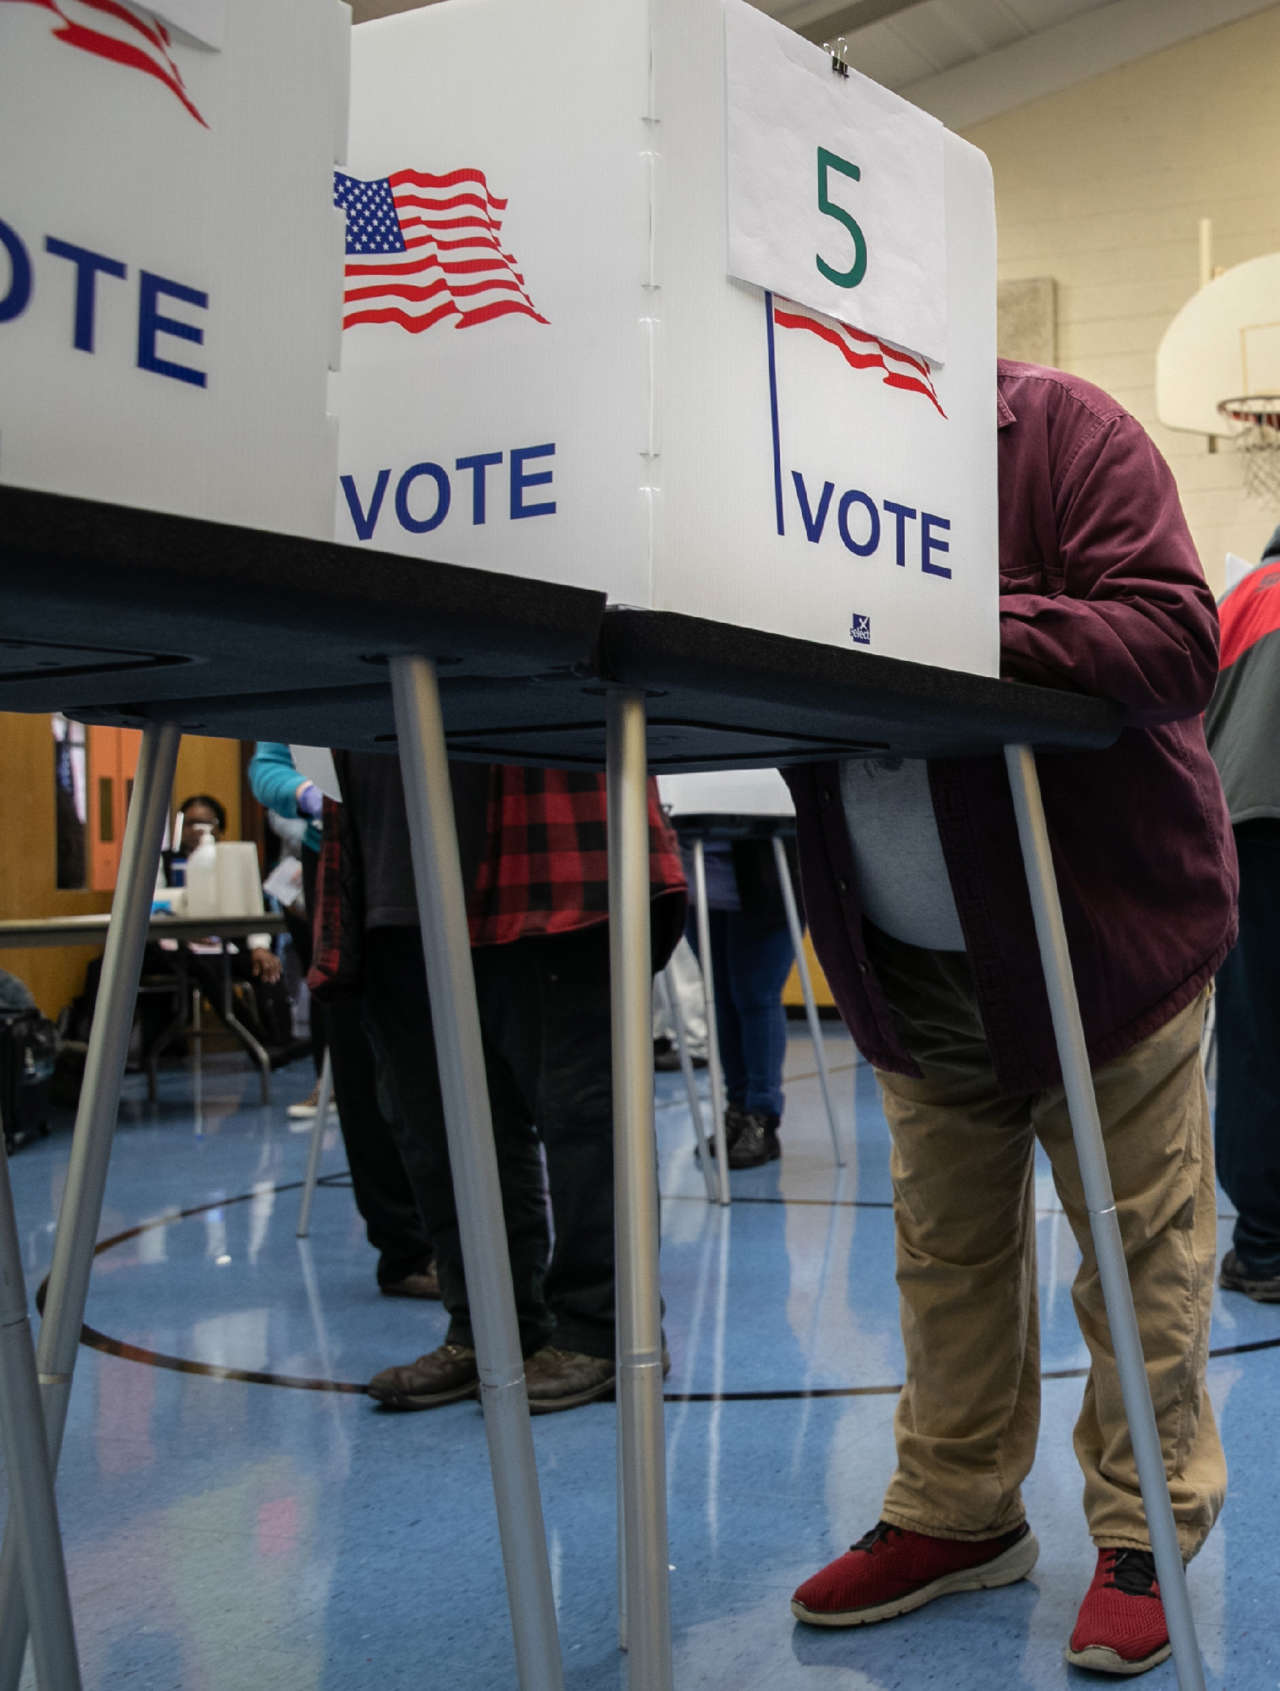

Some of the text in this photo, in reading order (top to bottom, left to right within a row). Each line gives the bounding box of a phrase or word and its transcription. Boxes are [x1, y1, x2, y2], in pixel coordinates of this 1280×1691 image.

[816, 147, 867, 289] 5
[340, 443, 556, 541] VOTE
[791, 470, 952, 579] VOTE
